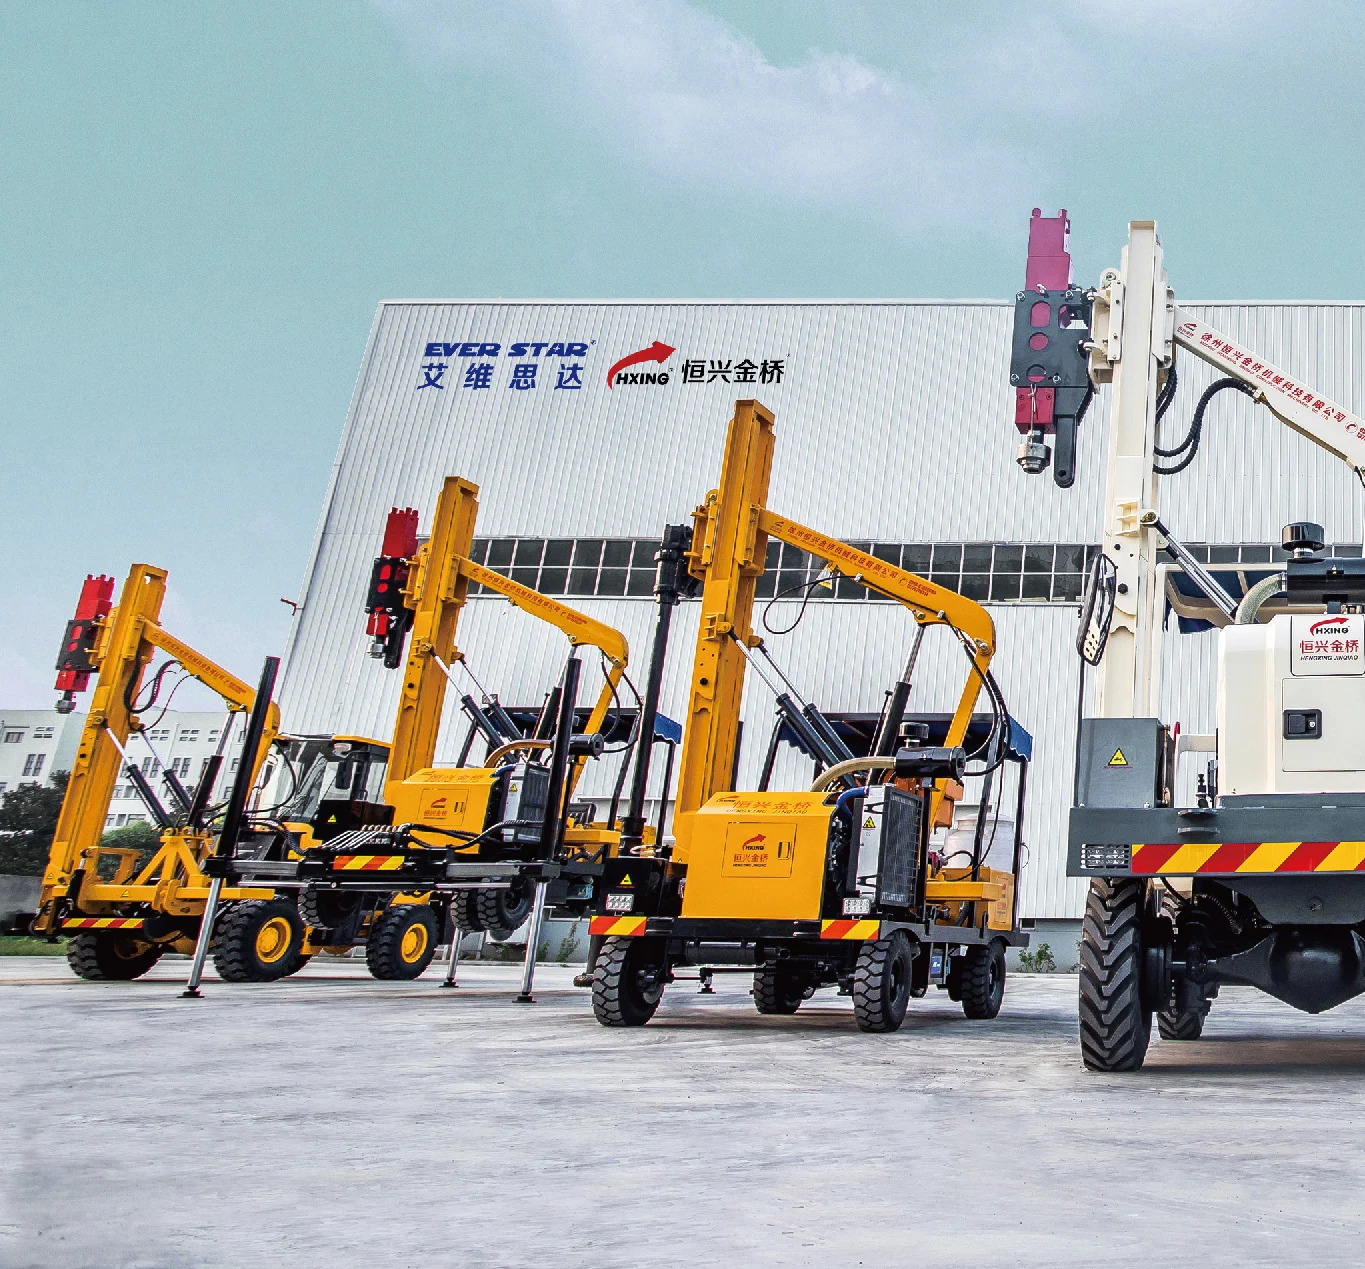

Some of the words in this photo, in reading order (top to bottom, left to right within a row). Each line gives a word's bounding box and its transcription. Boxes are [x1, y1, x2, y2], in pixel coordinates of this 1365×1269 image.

[424, 342, 501, 357] EVER
[507, 342, 589, 357] STAR
[417, 362, 584, 391] 艾维思达
[616, 372, 670, 386] HXING
[681, 359, 785, 384] 恒兴金桥
[1200, 332, 1347, 423] 徐州恒兴金桥机械科技有限公司
[1300, 639, 1359, 654] 恒兴金桥
